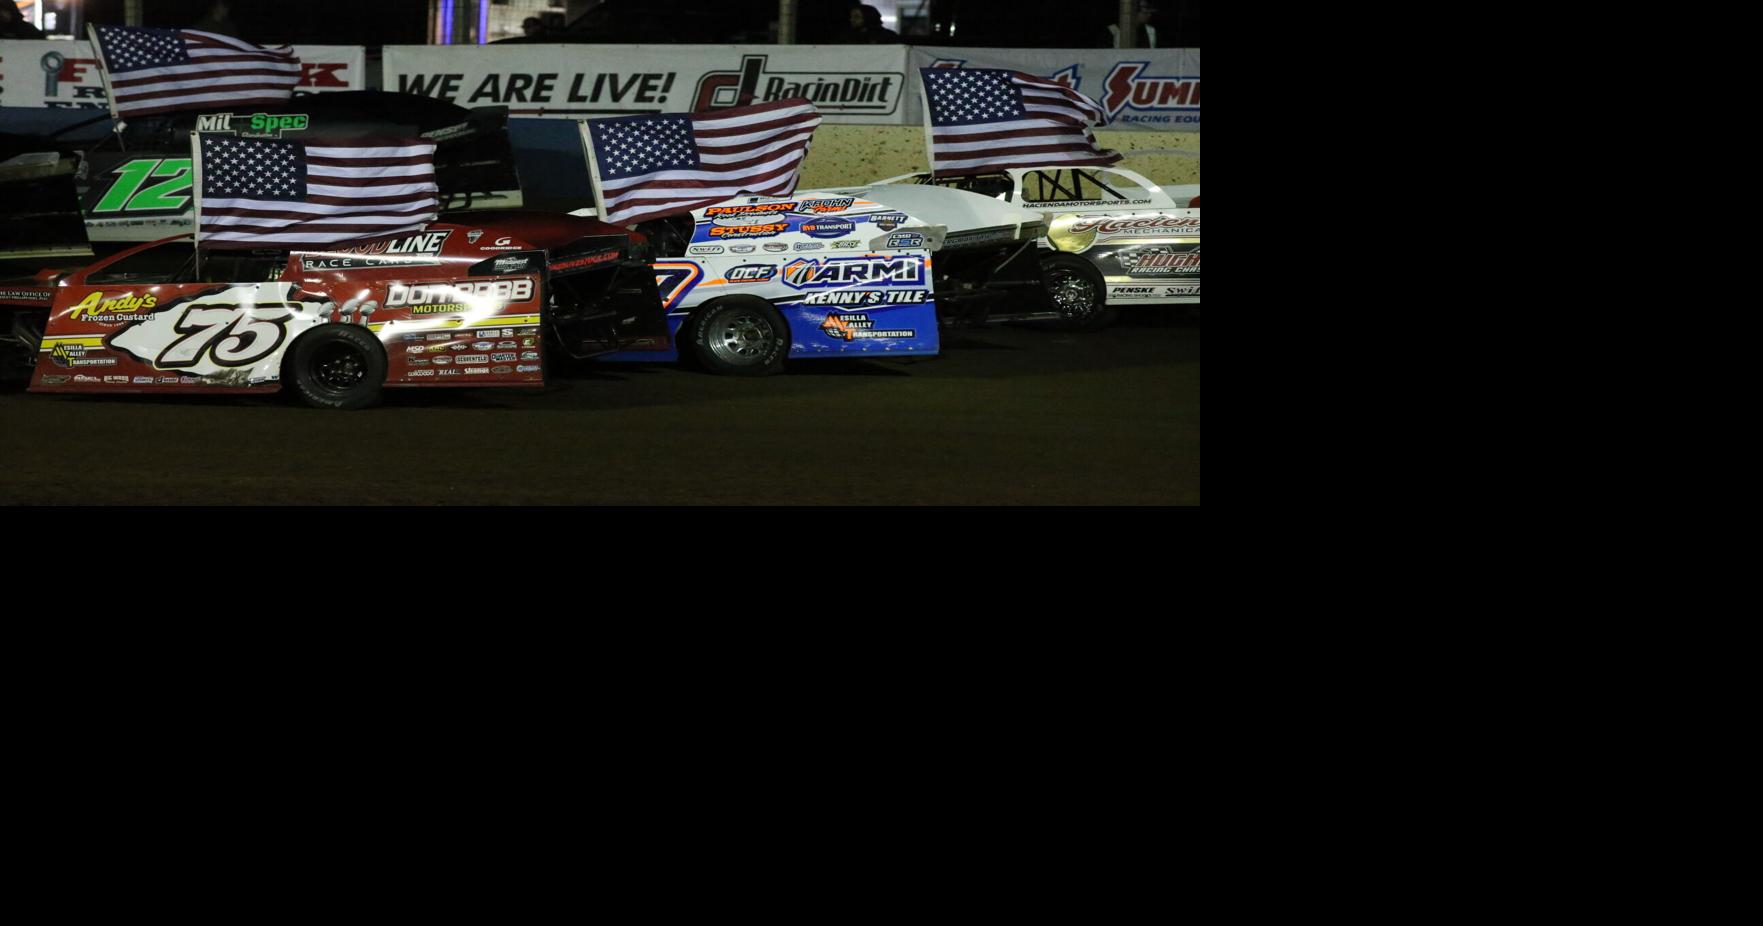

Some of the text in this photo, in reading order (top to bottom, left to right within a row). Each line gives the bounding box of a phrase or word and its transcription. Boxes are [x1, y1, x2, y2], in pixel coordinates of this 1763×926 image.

[399, 72, 677, 104] WE ARE LIVE!
[763, 76, 893, 103] RacinDirt
[199, 115, 306, 133] Mil Spec
[1121, 115, 1170, 123] RACING
[705, 203, 795, 217] PAULSON
[1022, 198, 1152, 208] HACIENDAMOTORSPORTS.COM
[709, 222, 788, 236] STUSSY
[816, 223, 852, 231] TRANSPORT
[305, 258, 352, 269] RACE
[811, 259, 920, 283] ARMI
[804, 290, 926, 304] KENNY'S TILE
[70, 291, 158, 319] Andy's
[81, 312, 155, 322] Frozen Custard
[155, 303, 303, 369] 75
